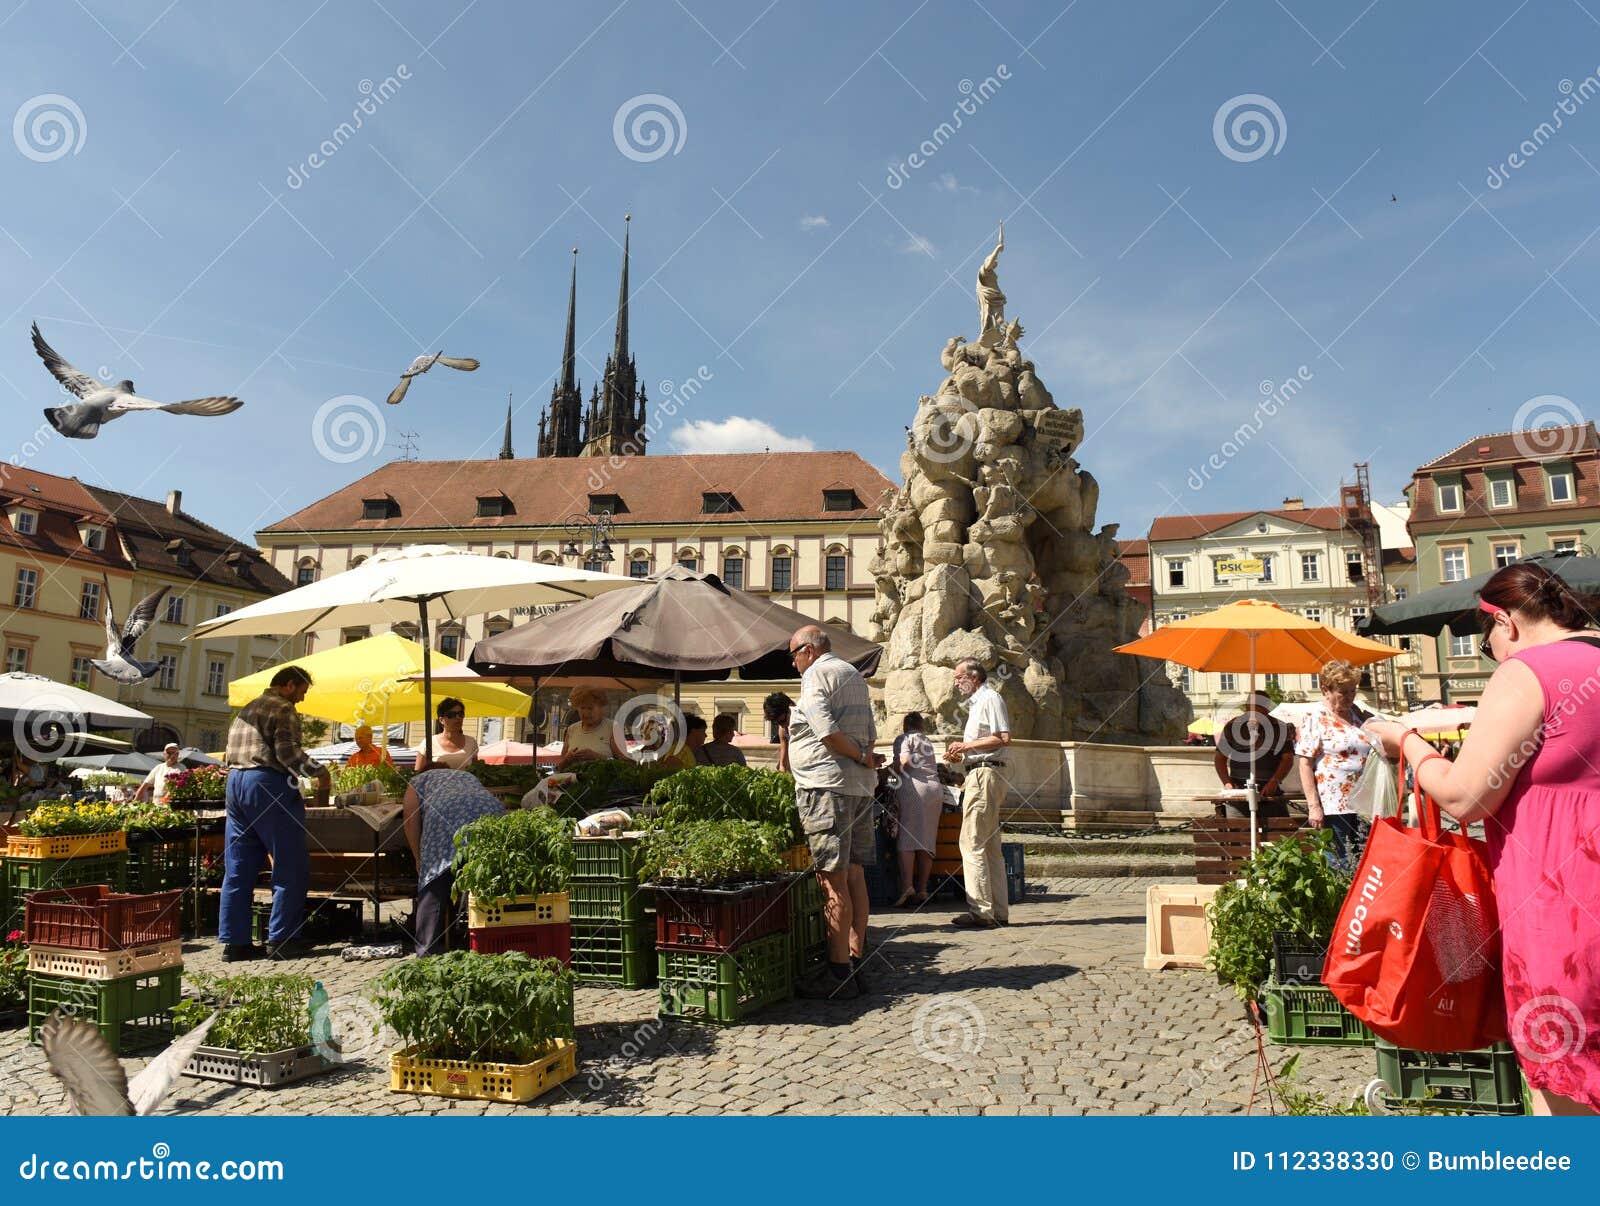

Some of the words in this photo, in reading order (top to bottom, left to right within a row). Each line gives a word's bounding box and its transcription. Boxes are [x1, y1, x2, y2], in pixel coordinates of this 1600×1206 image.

[1220, 563, 1242, 572] PSK
[514, 603, 570, 616] MORAVSK
[1345, 864, 1385, 956] riu.com
